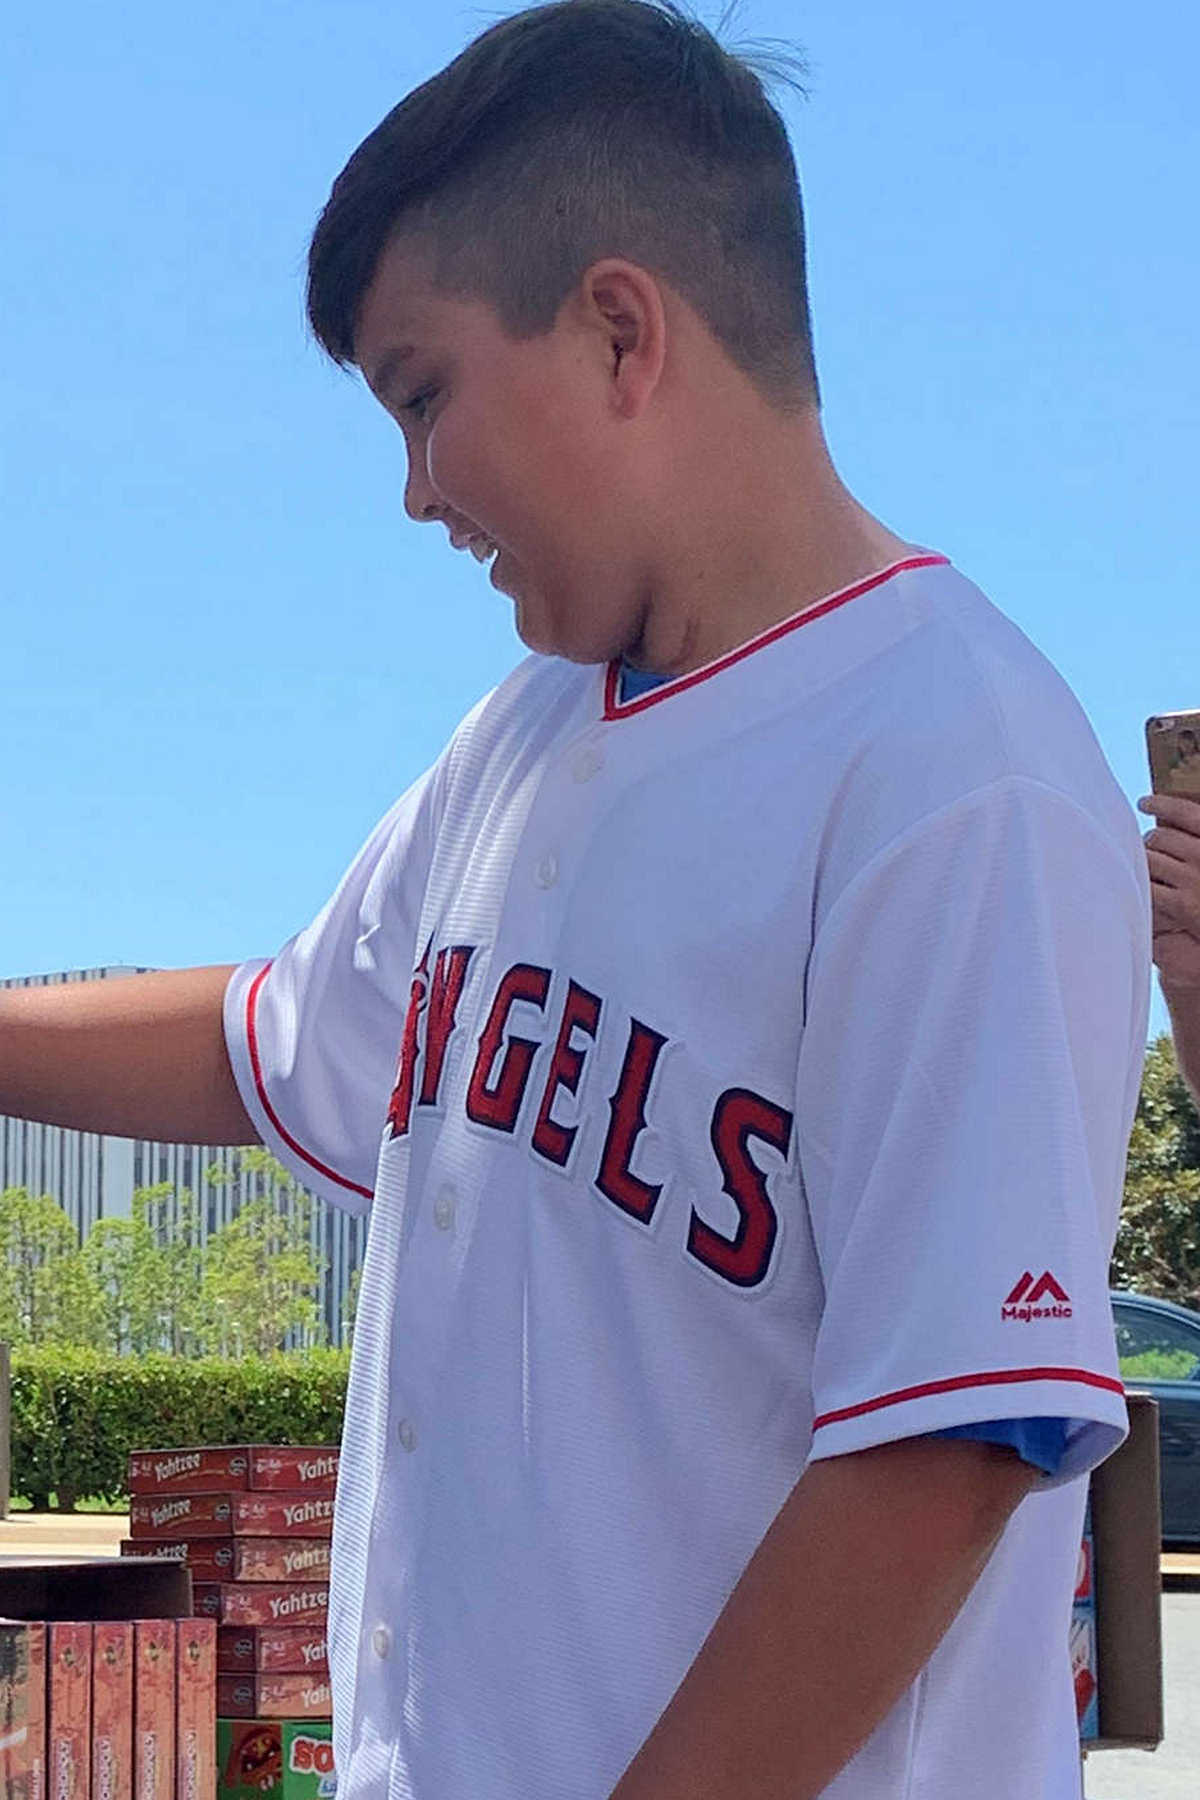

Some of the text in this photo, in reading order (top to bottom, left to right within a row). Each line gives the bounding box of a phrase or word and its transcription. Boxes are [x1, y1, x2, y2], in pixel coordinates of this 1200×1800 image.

[1001, 1304, 1072, 1323] Majestic
[154, 1453, 200, 1482] Yahtzee
[297, 1456, 339, 1481] Yaht
[151, 1499, 191, 1528] Yahtzee
